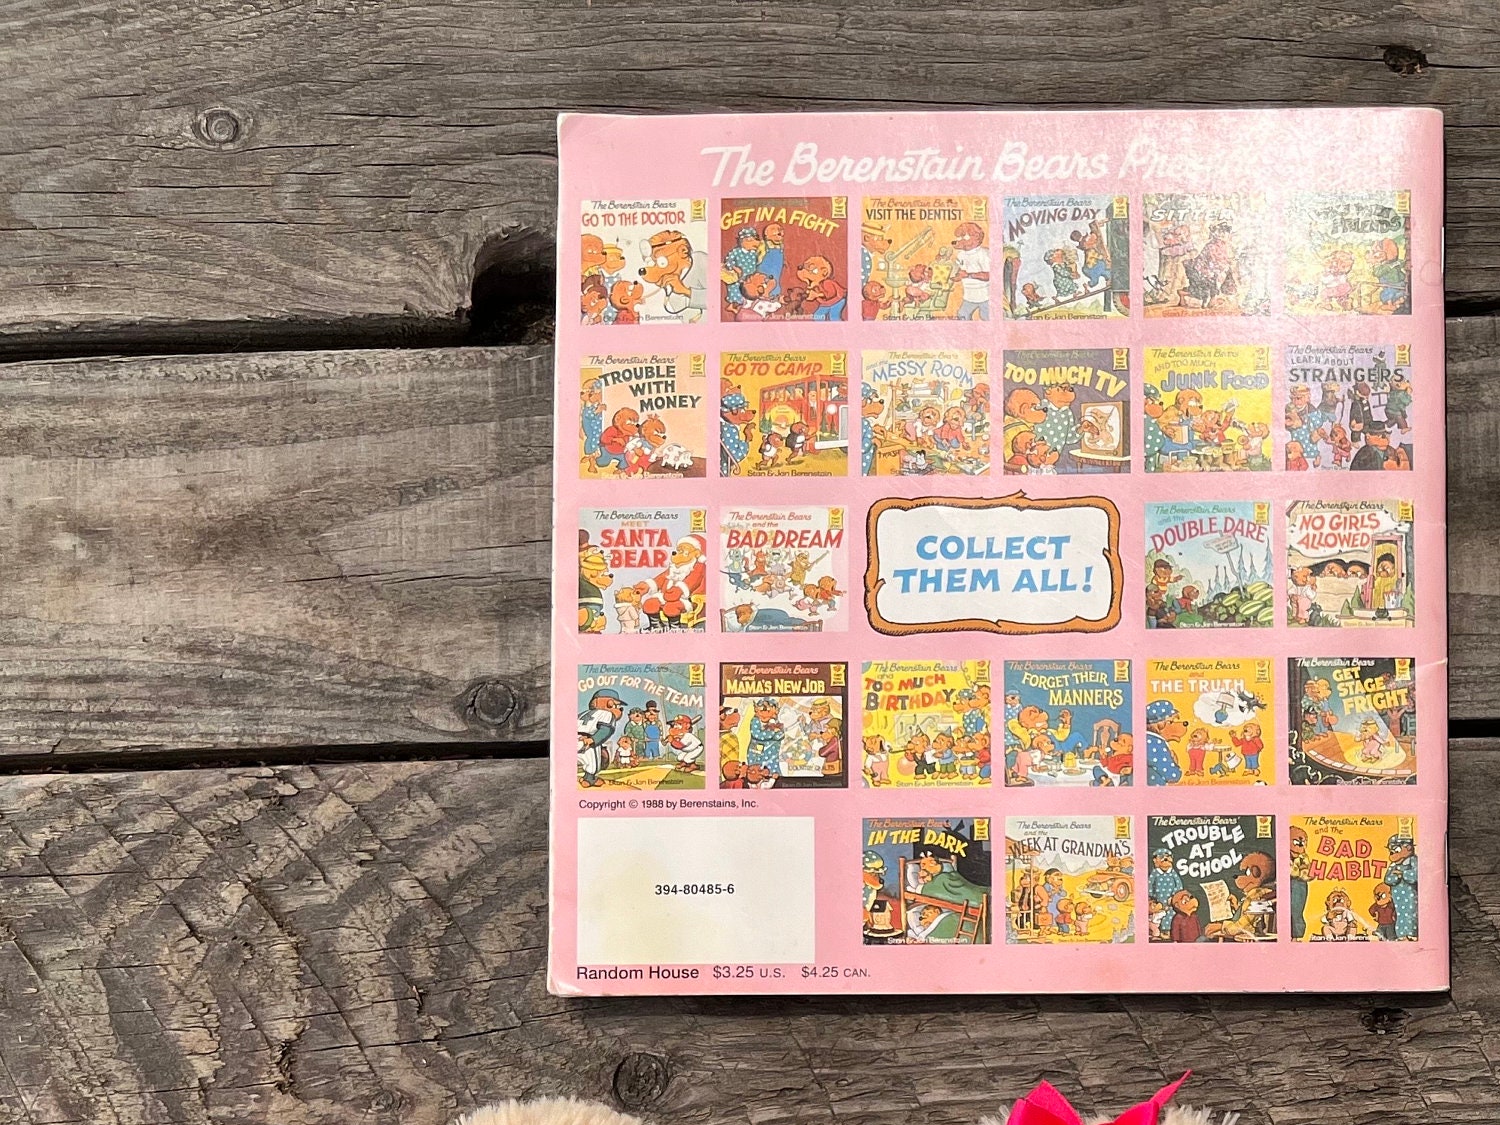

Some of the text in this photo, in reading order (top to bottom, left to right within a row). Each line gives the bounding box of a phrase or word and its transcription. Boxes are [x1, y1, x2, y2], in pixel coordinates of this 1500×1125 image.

[700, 143, 775, 189] The
[782, 142, 985, 187] Berenstain
[992, 140, 1109, 183] Bears
[582, 211, 686, 227] GO TO THE DOCTOR
[720, 207, 839, 238] GET IN A FIGHT
[865, 208, 963, 221] VISIT THE DENTIST
[1008, 207, 1100, 241] MOVING DAY
[729, 353, 806, 362] The Berenstain Bears
[598, 366, 676, 389] TROUBLE
[723, 362, 823, 377] GO TO CAMP
[628, 380, 676, 398] WITH
[1003, 362, 1128, 399] TOO MUCH TV
[639, 395, 702, 412] MONEY
[1299, 511, 1381, 531] NO GIRLS
[599, 528, 672, 548] SANTA
[726, 529, 844, 549] BAD DREAM
[1151, 515, 1269, 553] DOUBLE DARE
[1296, 530, 1371, 552] ALLOWED
[916, 535, 1071, 561] COLLECT
[609, 548, 667, 569] BEAR
[892, 565, 1093, 594] THEM ALL!
[726, 678, 826, 695] MAMA'S NEW JOB
[579, 799, 626, 811] Copyright
[641, 800, 664, 809] 1988
[666, 799, 677, 811] by
[679, 799, 739, 810] Berenstains,
[741, 799, 759, 808] Inc.
[867, 828, 970, 858] IN THE DARK
[654, 883, 735, 895] 394-80485-6
[576, 965, 871, 980] Random House $3.25 U.S. $4.25 CAN.
